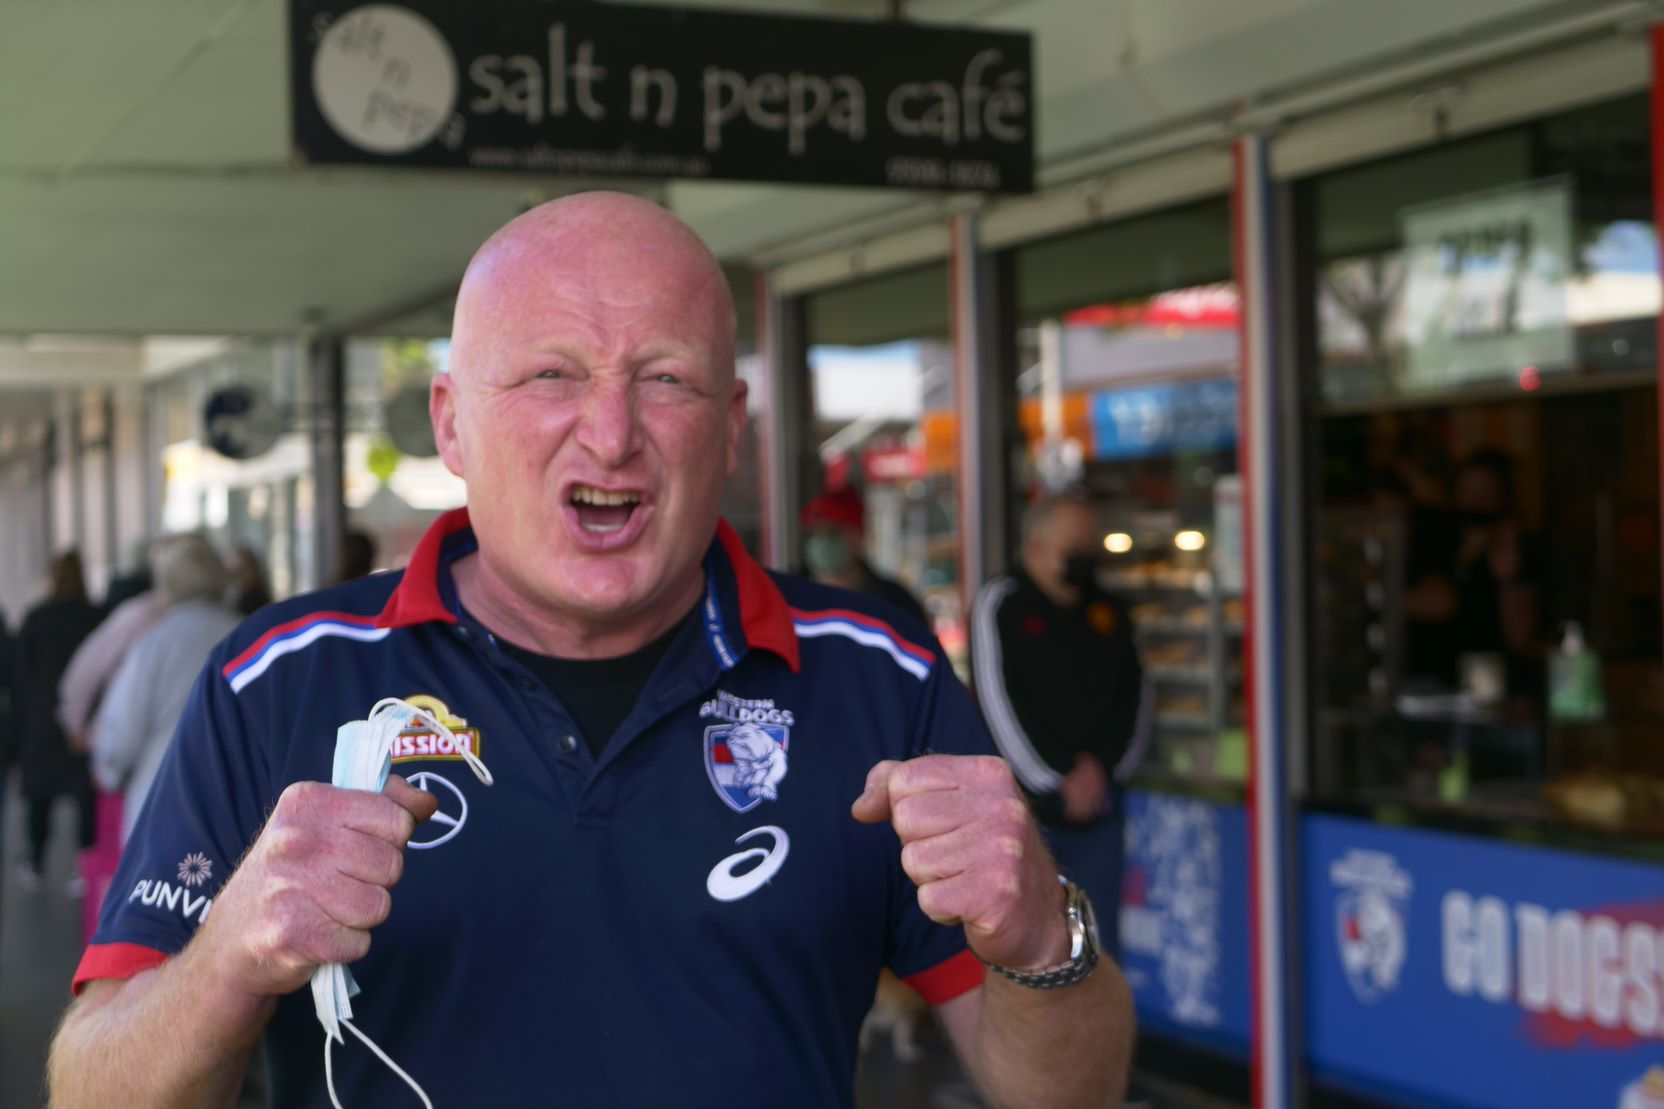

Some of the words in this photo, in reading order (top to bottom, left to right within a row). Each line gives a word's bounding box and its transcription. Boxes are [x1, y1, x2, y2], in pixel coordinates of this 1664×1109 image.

[468, 22, 607, 127] salt
[629, 64, 680, 128] n
[702, 64, 868, 155] pepa
[886, 48, 1027, 145] café
[389, 731, 474, 757] ISSION
[698, 698, 795, 726] BULLDOGS
[1441, 889, 1511, 1005] GO
[1513, 901, 1664, 1038] DOGS
